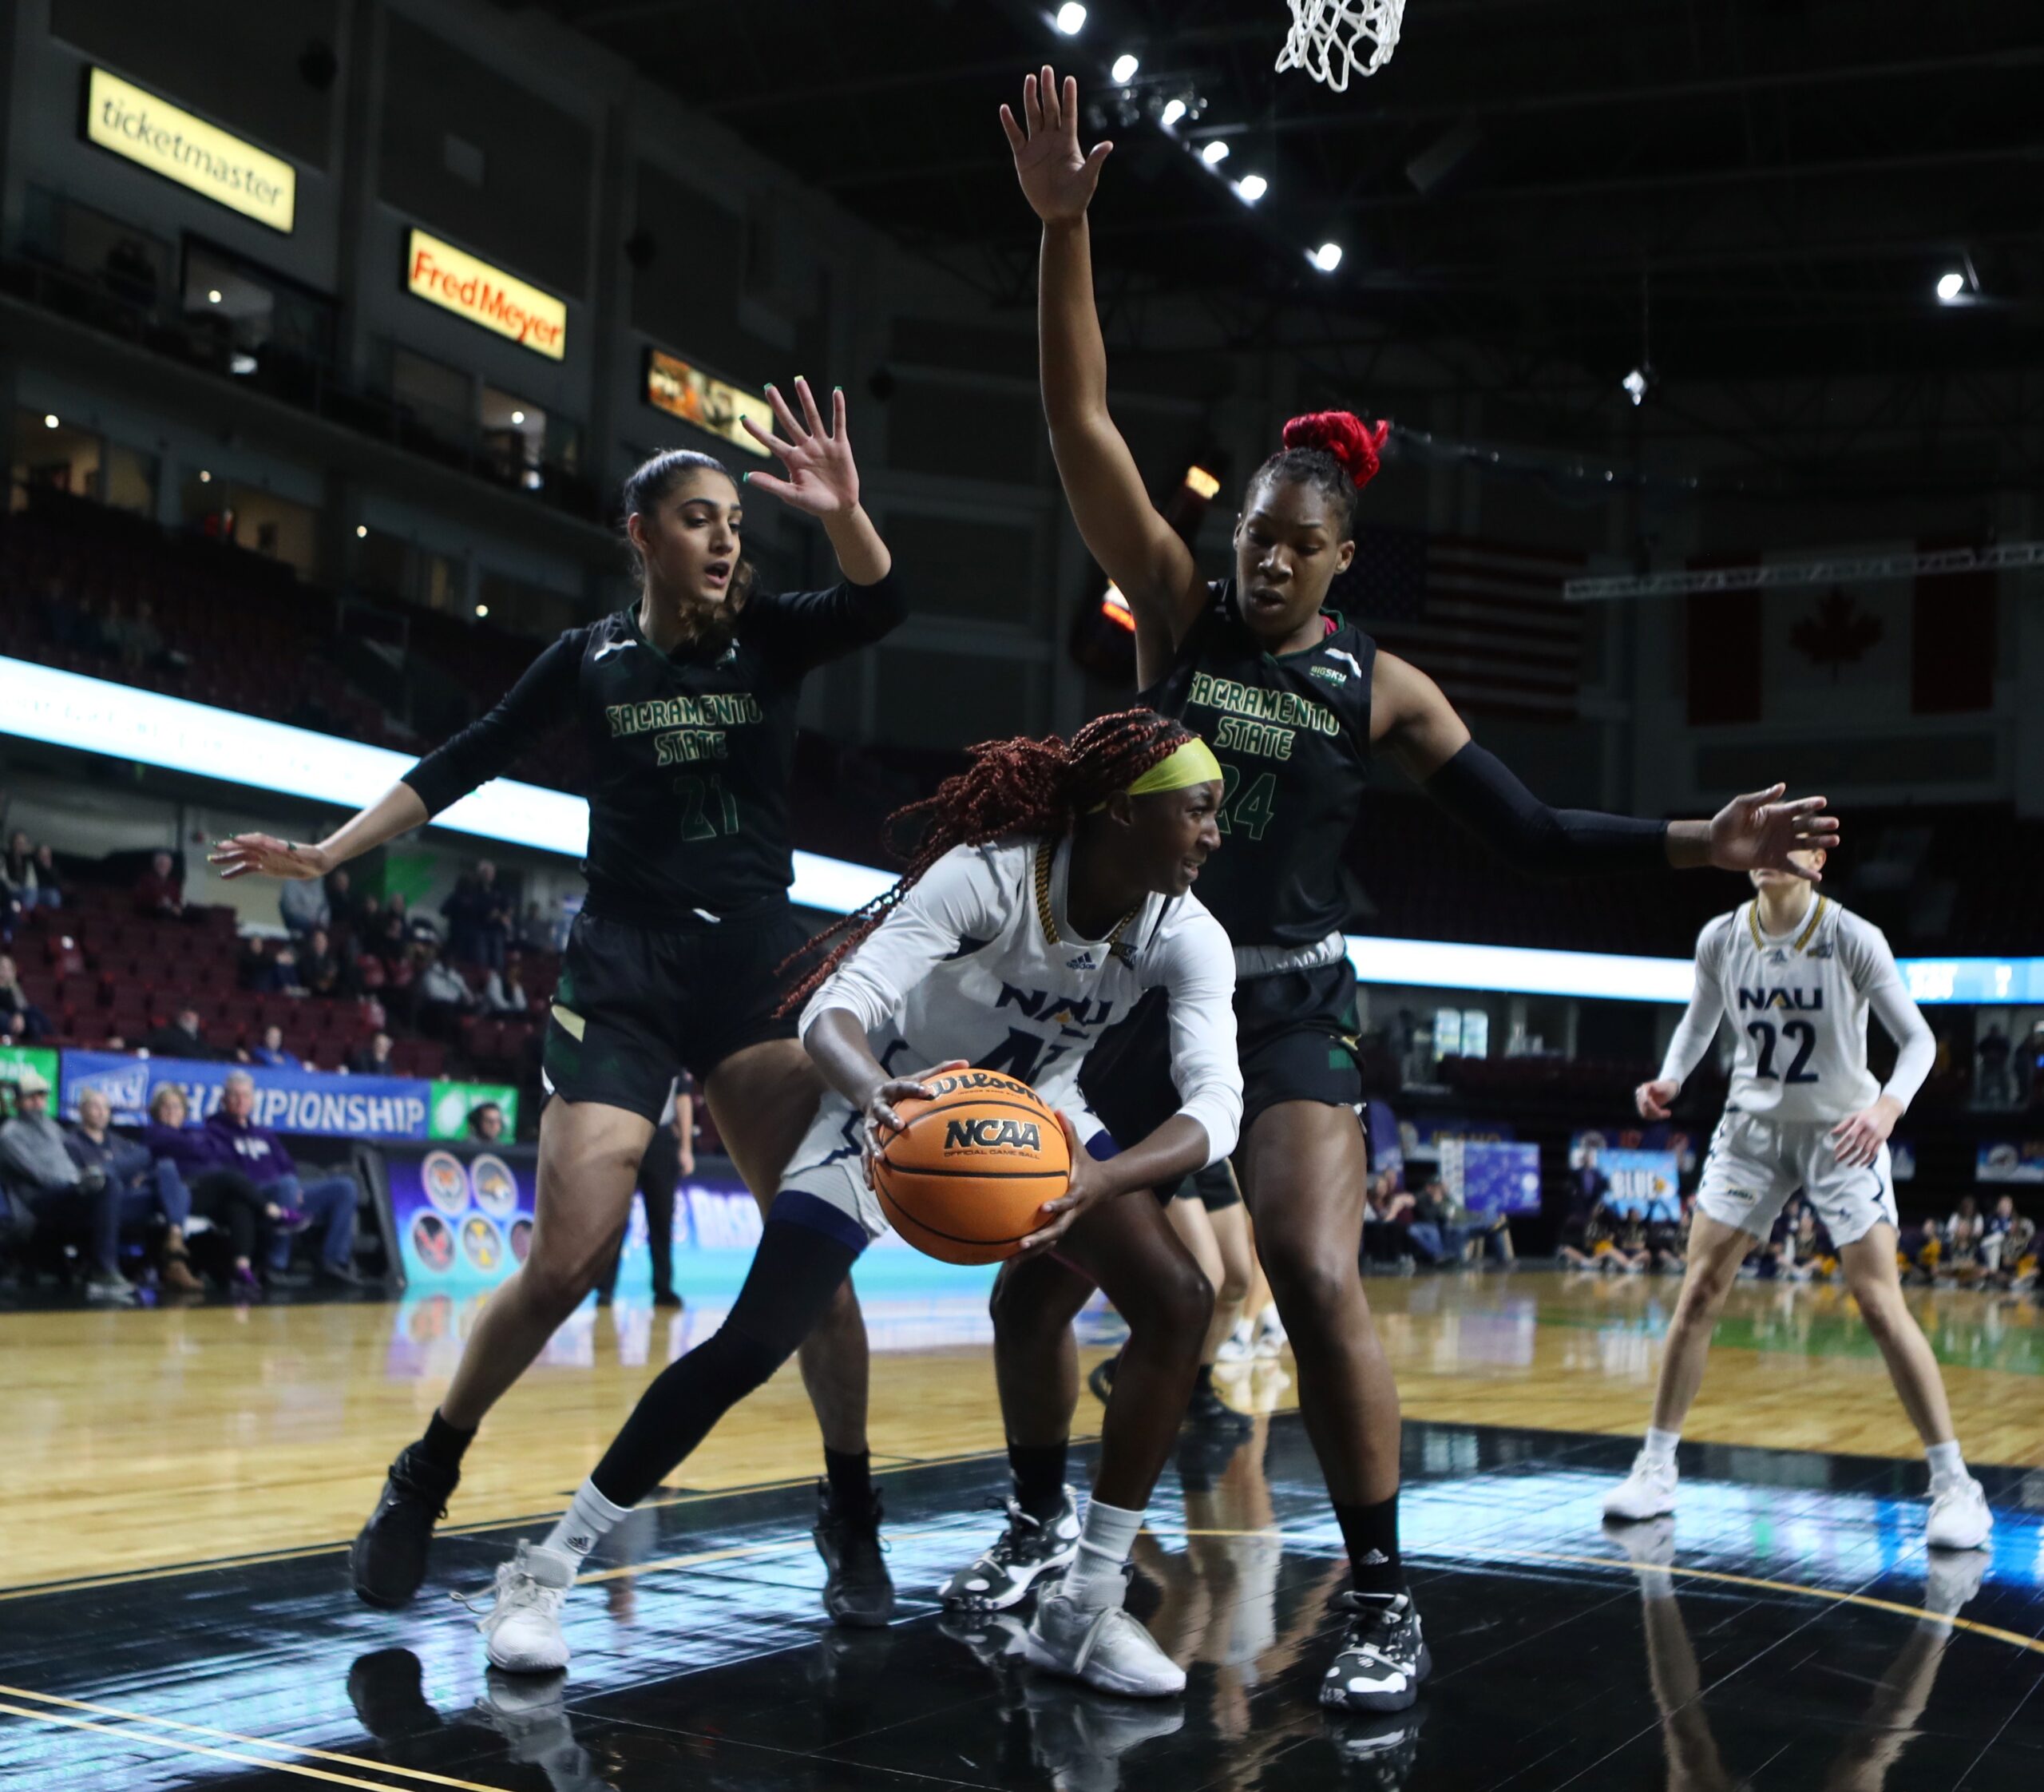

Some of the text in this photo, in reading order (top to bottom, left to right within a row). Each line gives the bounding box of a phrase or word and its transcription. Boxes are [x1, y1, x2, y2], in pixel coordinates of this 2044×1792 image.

[101, 97, 283, 206] ticketmaster
[606, 692, 763, 738] SACRAMENTO
[655, 730, 729, 767] STATE
[1213, 716, 1297, 761] STATE
[672, 773, 739, 842] 21
[994, 981, 1114, 1027] NAU
[1738, 987, 1824, 1011] NAU
[1746, 1018, 1820, 1084] 22
[944, 1119, 1042, 1152] NCAA
